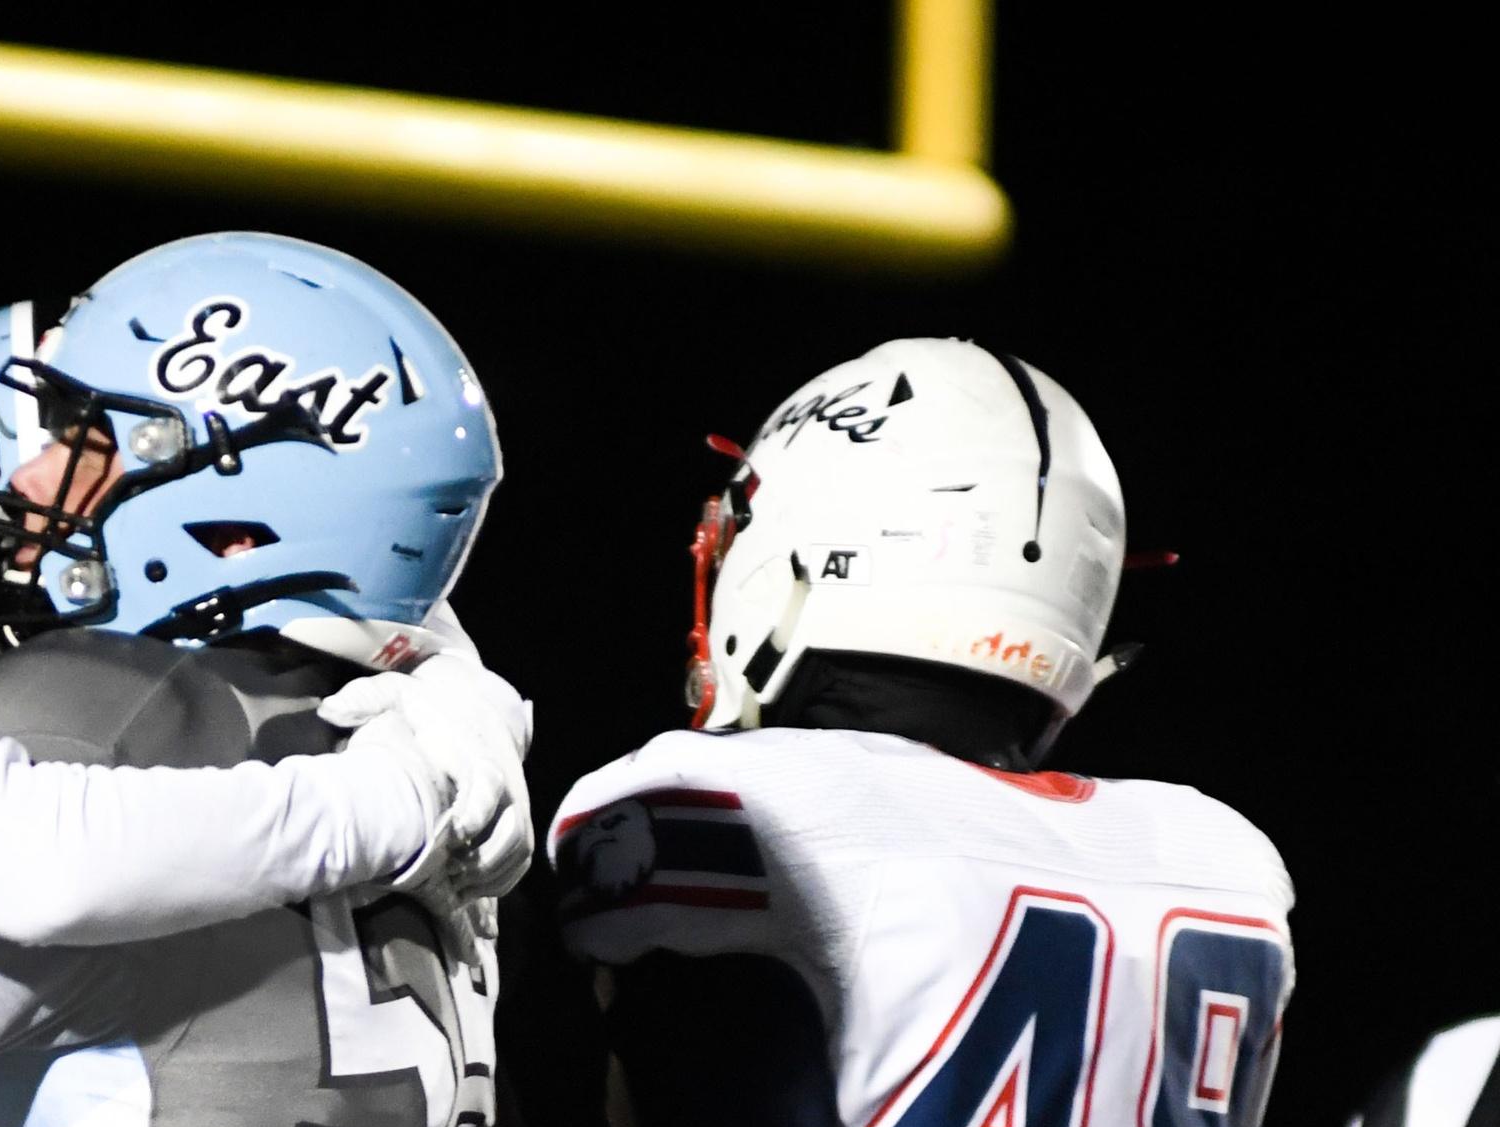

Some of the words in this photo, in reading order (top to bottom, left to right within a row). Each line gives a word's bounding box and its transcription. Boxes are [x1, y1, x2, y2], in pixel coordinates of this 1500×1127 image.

[153, 298, 392, 448] East
[760, 381, 889, 448] agles
[820, 550, 859, 579] AT
